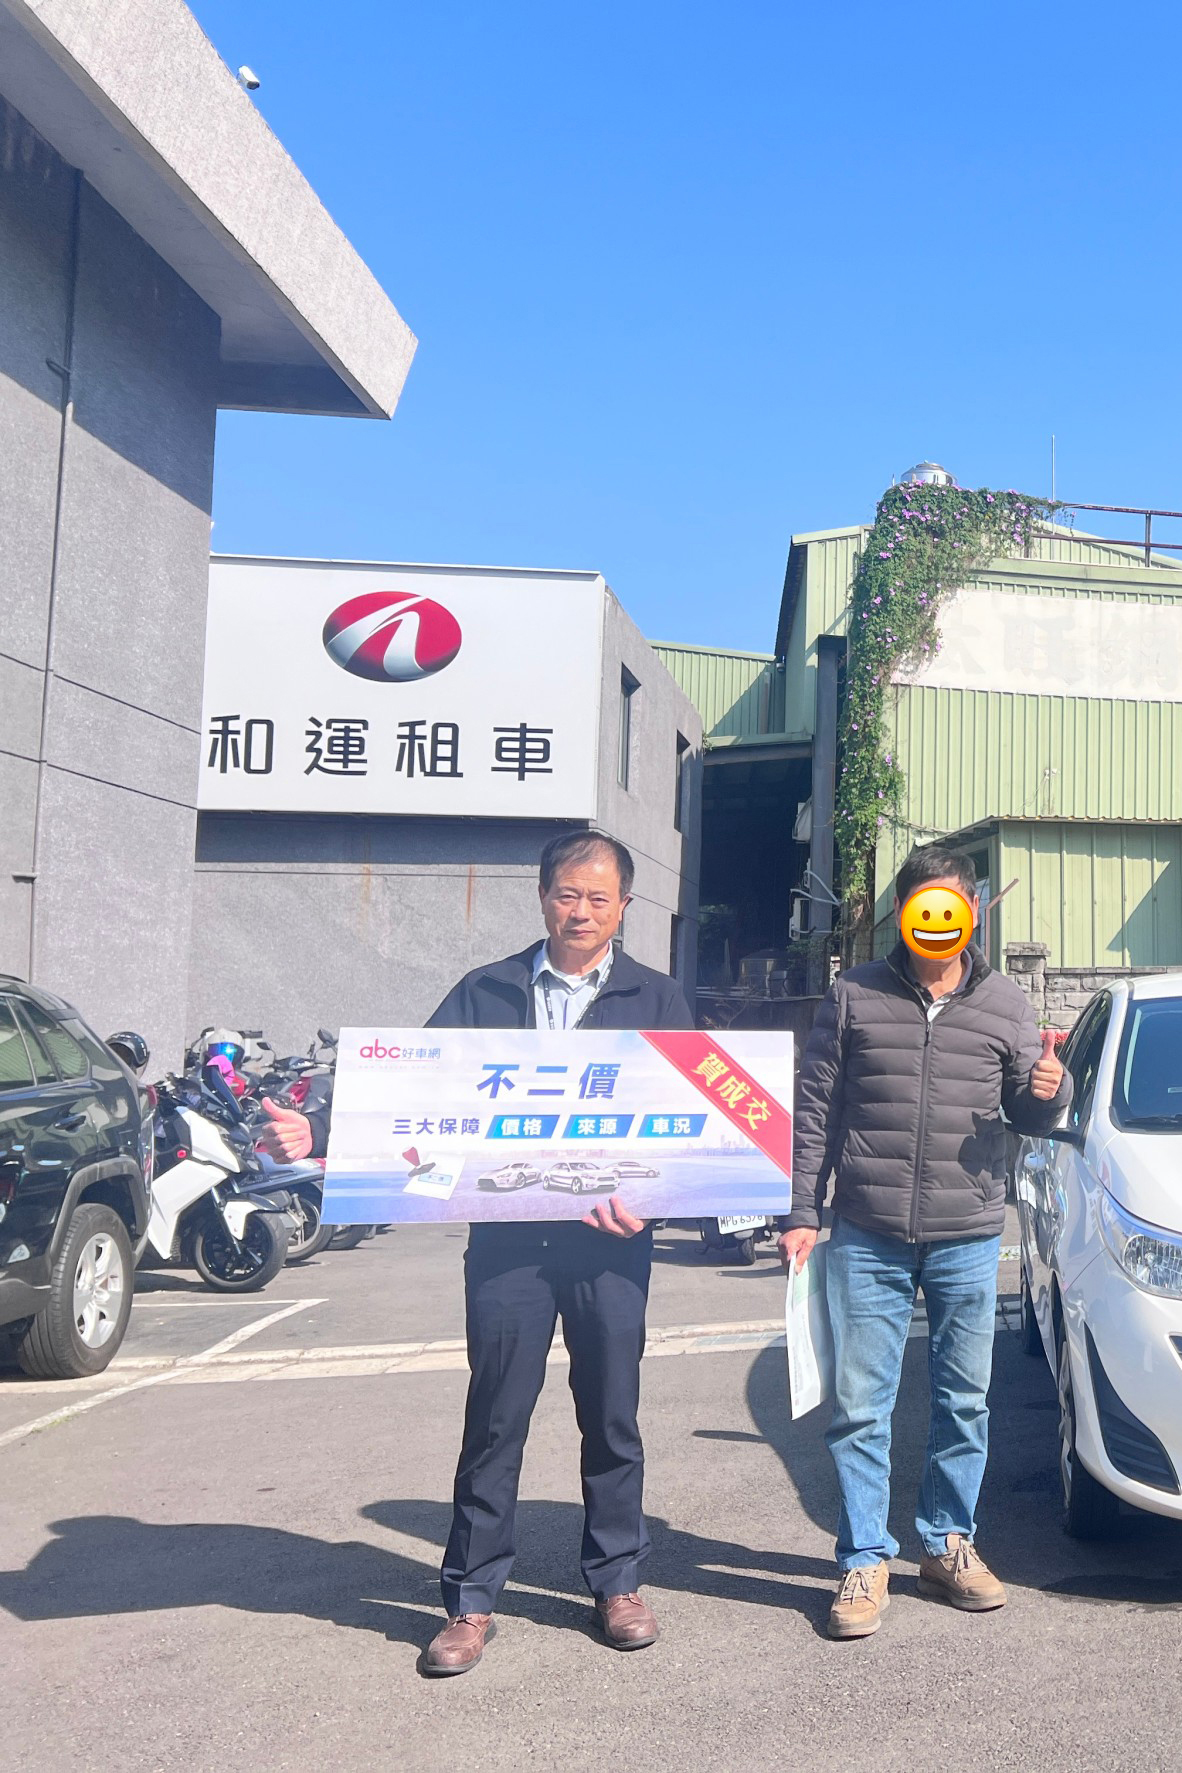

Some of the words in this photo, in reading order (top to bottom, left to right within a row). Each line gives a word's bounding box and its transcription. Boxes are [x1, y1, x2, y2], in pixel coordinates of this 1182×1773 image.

[207, 713, 554, 781] 和運租車
[476, 1062, 621, 1100] 不二價
[690, 1051, 772, 1130] 賀成交
[392, 1117, 481, 1135] 三大保障
[501, 1118, 542, 1136] 價格
[577, 1118, 618, 1135] 來源
[652, 1117, 691, 1135] 車況
